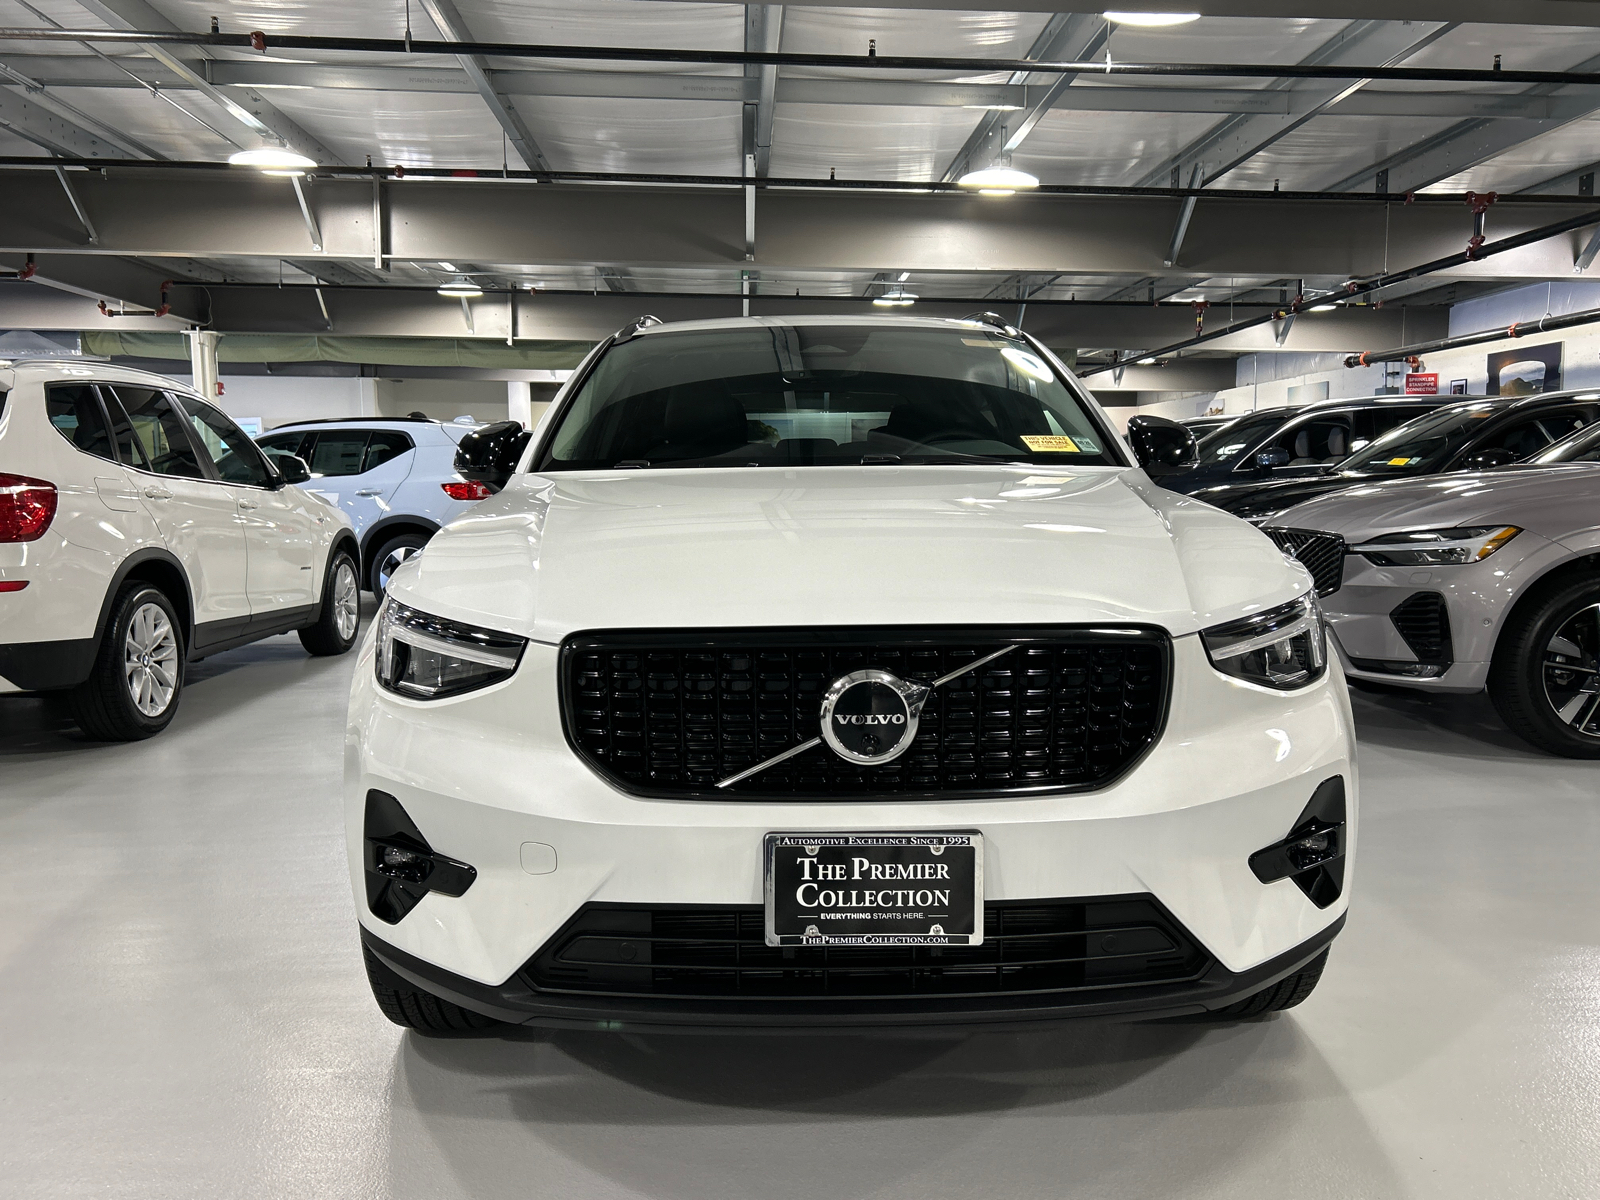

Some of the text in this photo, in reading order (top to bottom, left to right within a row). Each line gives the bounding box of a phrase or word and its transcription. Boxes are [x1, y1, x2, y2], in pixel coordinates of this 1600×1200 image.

[835, 714, 905, 725] VOLVO
[782, 837, 968, 845] AUTOMOTIVE EXCELLENCE SINCE 1995
[796, 857, 950, 880] THE PREMIER
[796, 882, 950, 908] COLLECTION
[820, 912, 871, 920] EVERYTHING
